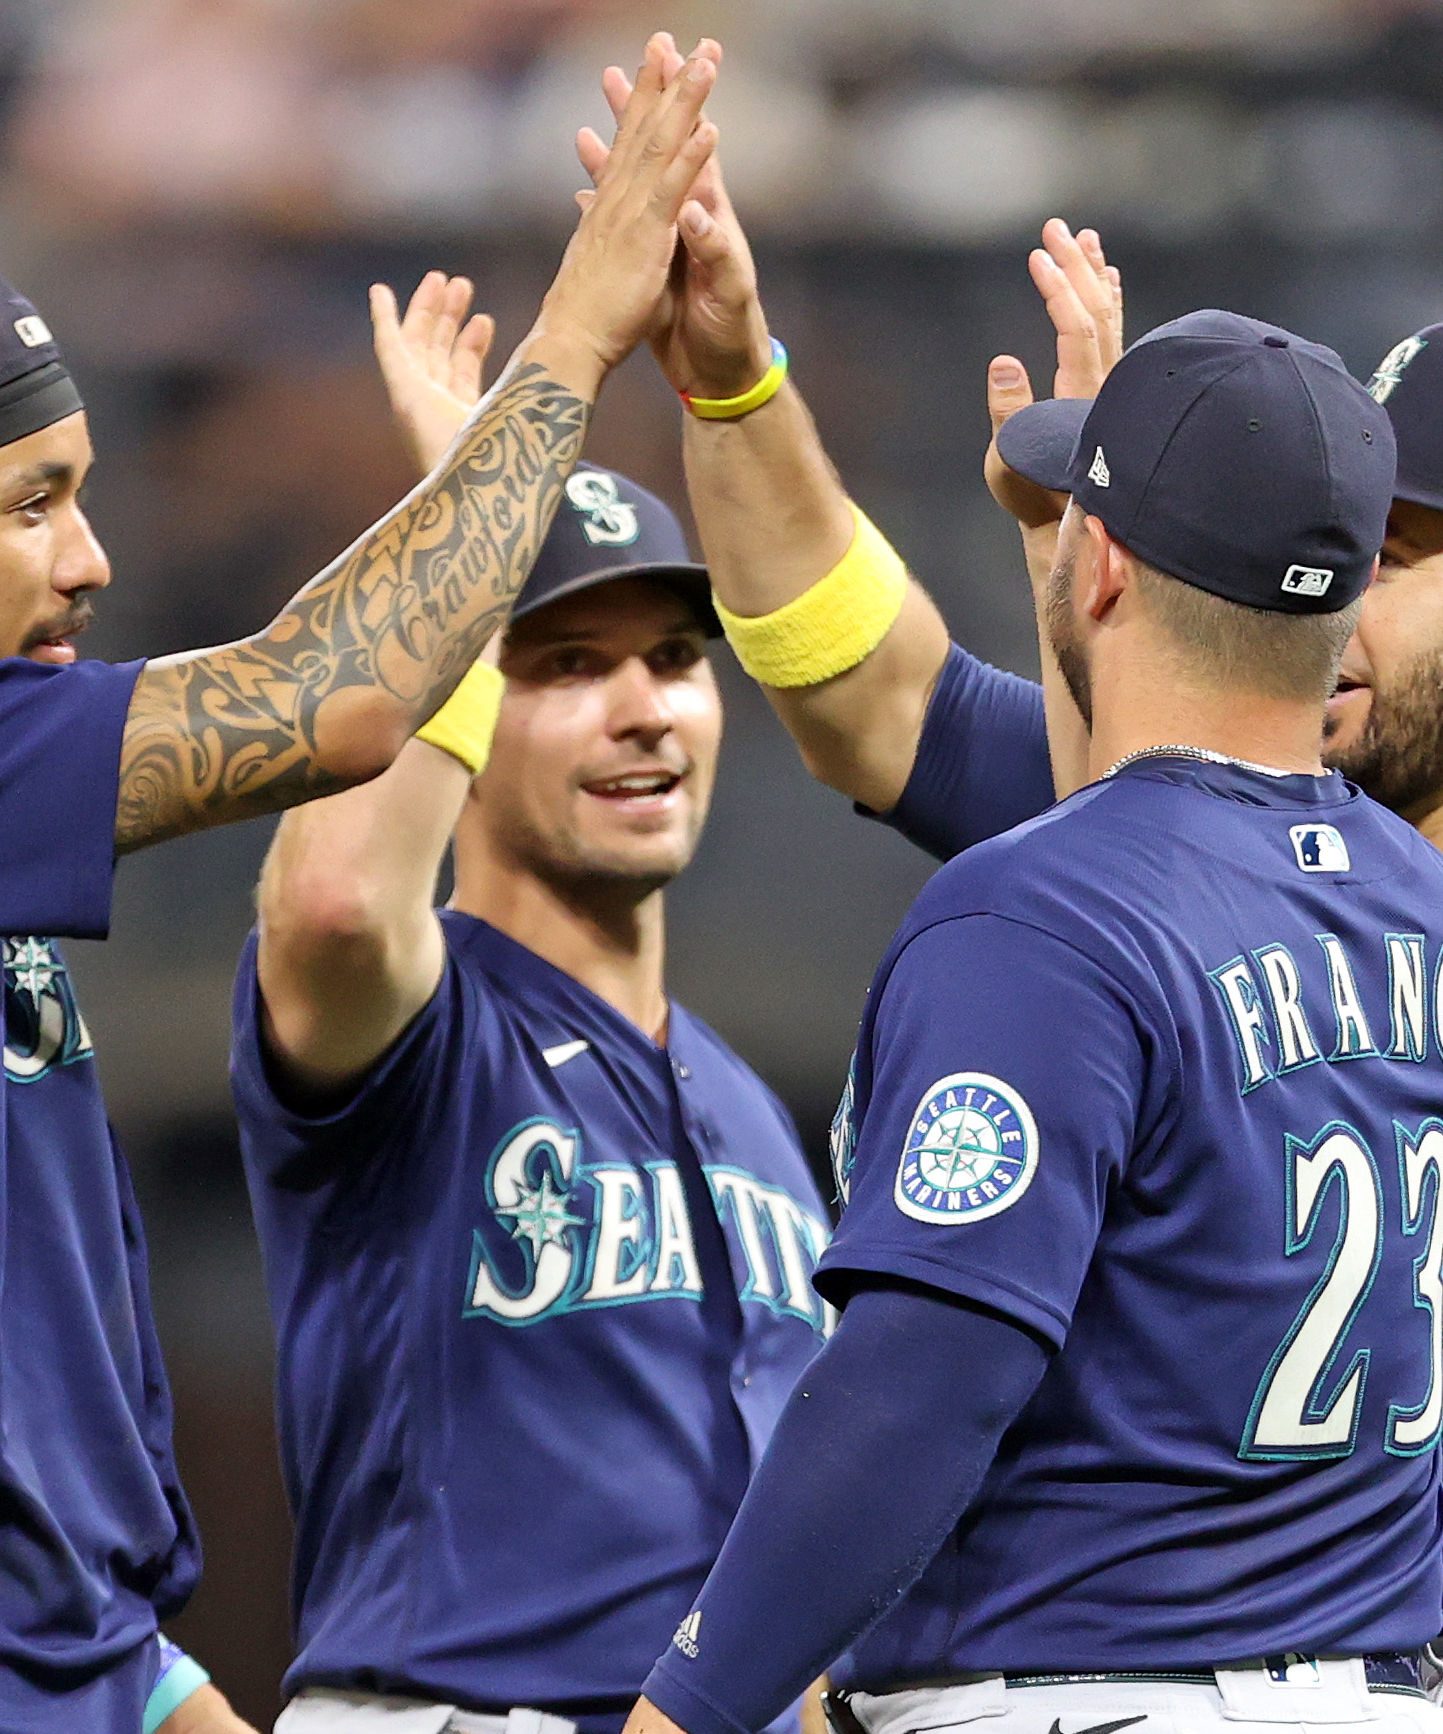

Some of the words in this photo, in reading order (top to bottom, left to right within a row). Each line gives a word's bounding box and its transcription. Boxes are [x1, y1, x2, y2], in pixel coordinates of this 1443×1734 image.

[563, 468, 641, 548] S
[916, 1087, 1021, 1143] SEATTLE
[903, 1162, 1013, 1210] MARINERS
